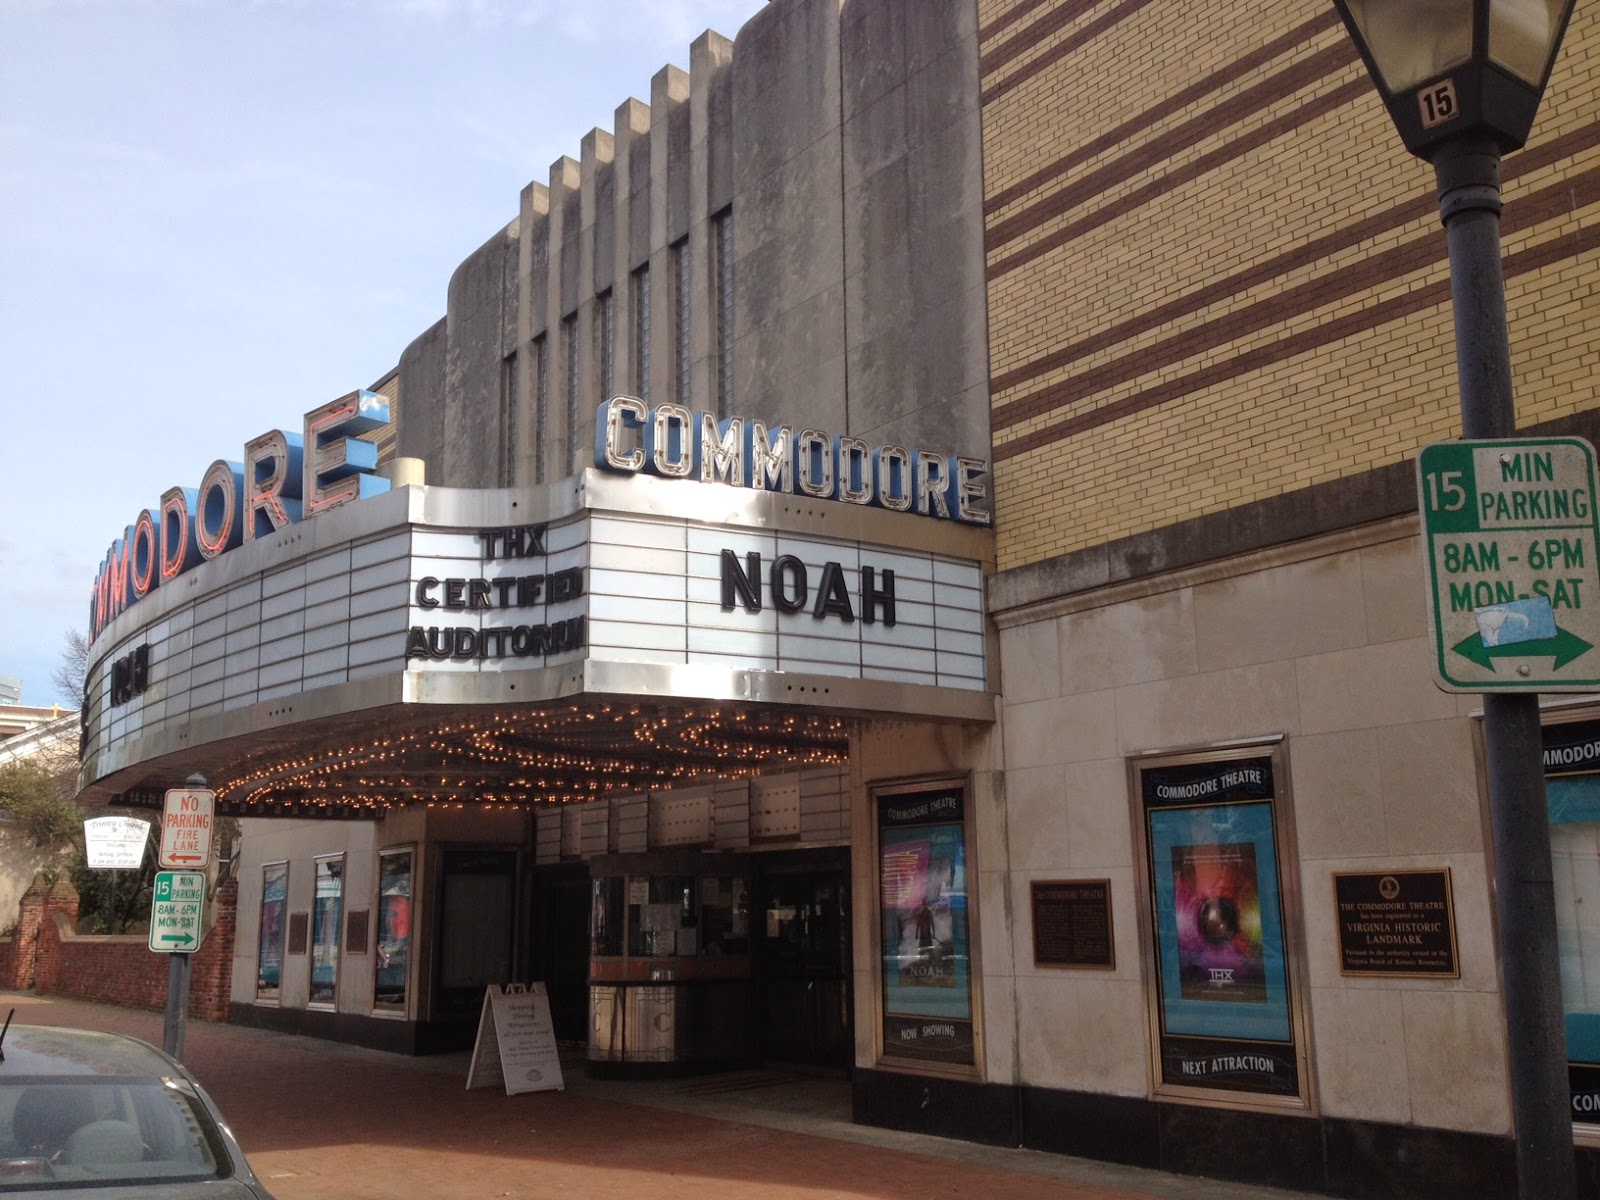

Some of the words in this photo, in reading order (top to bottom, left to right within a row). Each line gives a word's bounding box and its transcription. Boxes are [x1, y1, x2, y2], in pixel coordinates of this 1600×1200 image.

[1423, 86, 1453, 121] 15
[600, 395, 992, 526] COMMODORE
[1500, 452, 1554, 483] MIN
[1426, 471, 1467, 513] 15
[1480, 488, 1588, 521] PARKING
[479, 523, 548, 558] THX
[1443, 541, 1500, 573] 8AM
[1527, 538, 1585, 571] 6PM
[418, 566, 583, 609] CERTIFIED
[721, 548, 896, 628] NOAH
[1156, 781, 1218, 799] COMMODORE
[1220, 769, 1261, 790] THEATRE
[180, 797, 199, 810] NO
[887, 804, 928, 820] COMMODORE
[930, 797, 957, 812] THEATRE
[166, 813, 209, 829] PARKING
[176, 830, 198, 840] FIRE
[173, 841, 200, 851] LANE
[157, 881, 170, 896] 15
[180, 877, 194, 887] MIN
[172, 889, 200, 900] PARKING
[157, 905, 175, 915] 8AM
[181, 905, 197, 915] 6PM
[1341, 903, 1355, 911] THE
[1357, 902, 1407, 910] COMMODORE
[1409, 902, 1444, 910] THEATRE
[1346, 923, 1391, 932] VIRGINIA
[1394, 922, 1441, 932] HISTORIC
[1366, 935, 1423, 944] LANDMARK
[910, 966, 944, 977] NOAH
[1209, 969, 1234, 982] THX
[901, 1026, 917, 1040] NOW
[922, 1024, 955, 1038] SHOWING
[1182, 1060, 1207, 1075] NEXT
[1211, 1056, 1275, 1074] ATTRACTION
